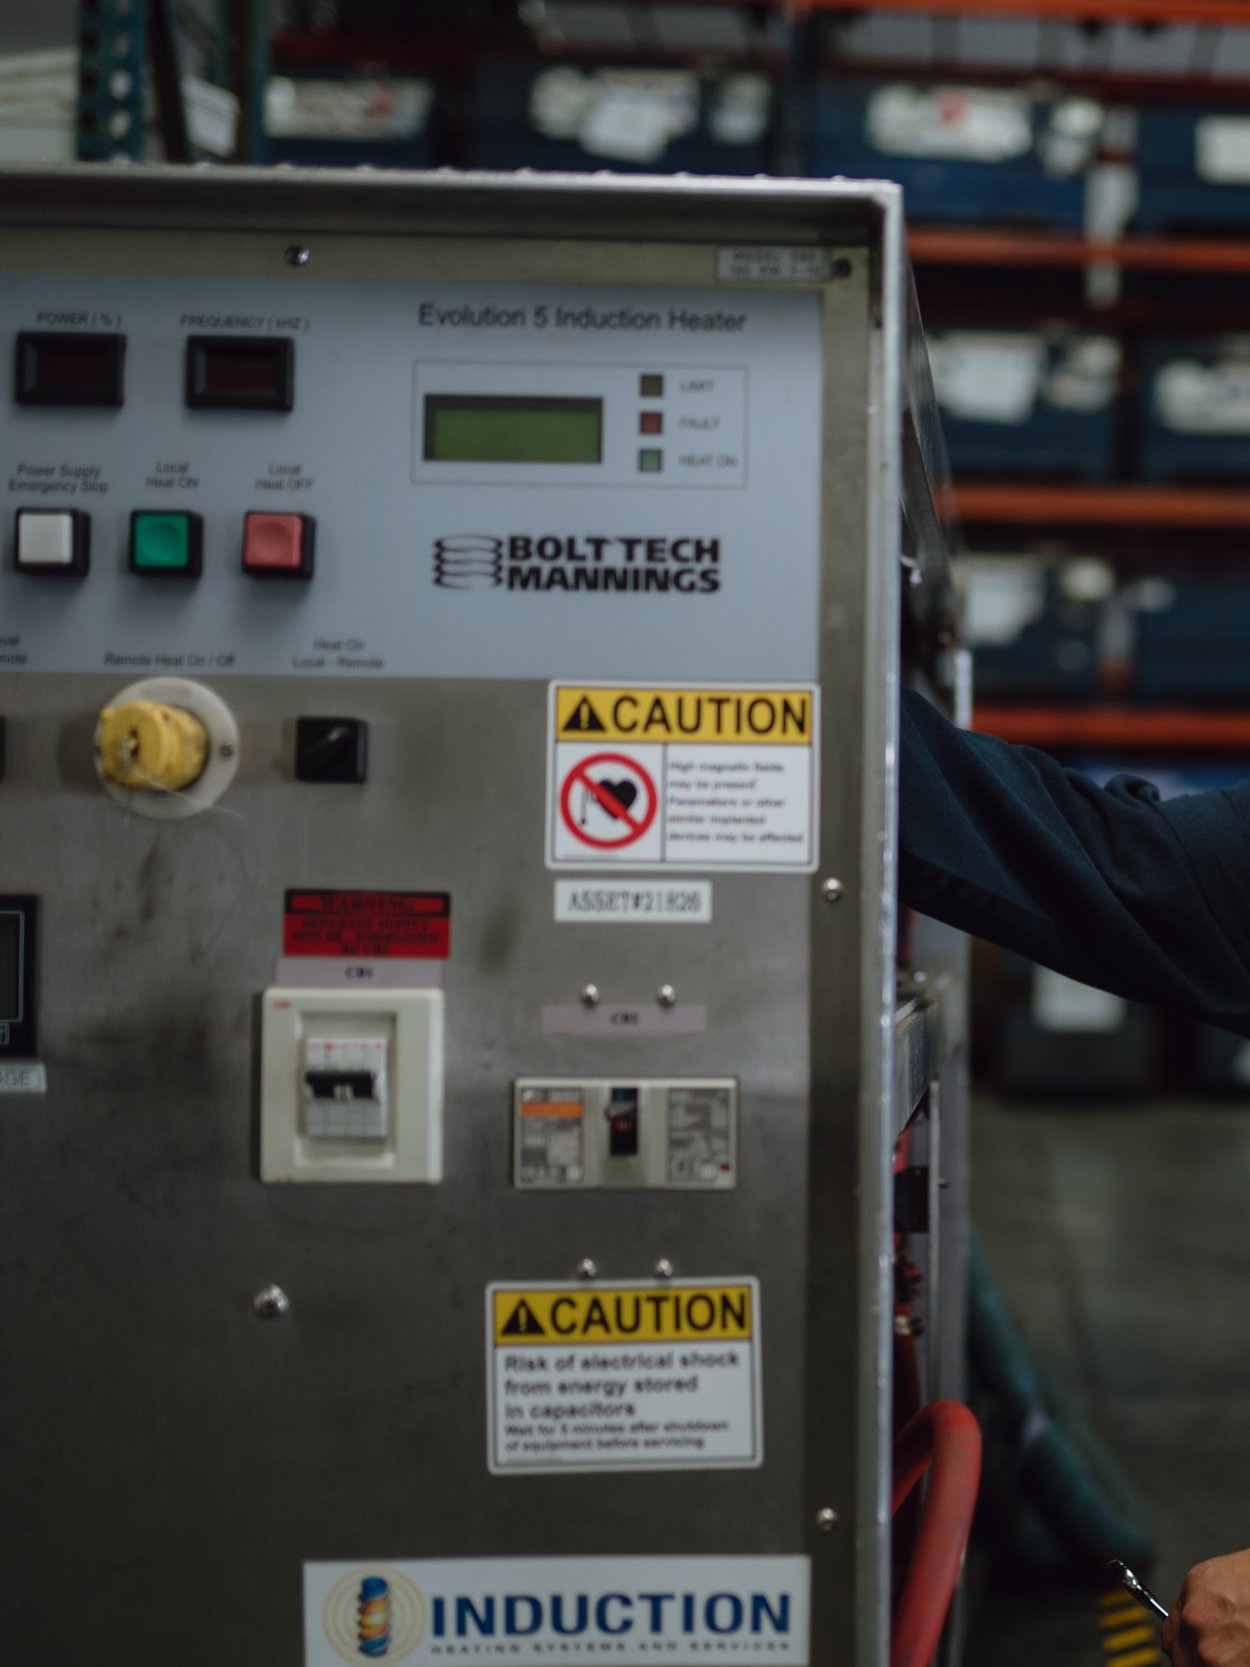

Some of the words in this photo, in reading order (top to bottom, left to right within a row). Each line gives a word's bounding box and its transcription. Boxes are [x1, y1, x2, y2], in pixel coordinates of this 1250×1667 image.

[36, 312, 89, 325] POWER
[179, 315, 265, 329] FREQUENCY
[418, 303, 525, 327] Evolution
[533, 305, 548, 328] 5
[555, 305, 661, 330] Induction
[667, 305, 746, 332] Heater
[679, 415, 720, 430] FAULT
[155, 461, 190, 474] Local
[678, 453, 714, 467] HEAT
[716, 454, 738, 468] ON
[17, 463, 57, 477] Power
[60, 463, 102, 480] Supply
[268, 462, 302, 476] Local
[8, 479, 78, 496] Emergency
[80, 480, 110, 495] Stop
[145, 477, 174, 489] Heat
[177, 477, 199, 489] ON
[255, 478, 284, 491] Heat
[286, 478, 314, 491] OFF
[506, 535, 614, 563] BOLT
[612, 538, 721, 564] TECH
[506, 565, 721, 593] MANNINGS
[313, 638, 344, 651] Heat
[348, 639, 365, 651] On
[104, 654, 151, 667] Remote
[155, 654, 185, 667] Heat
[188, 655, 206, 667] On
[218, 655, 236, 667] Off
[293, 656, 324, 669] Local
[337, 656, 384, 670] Remote
[611, 695, 807, 736] CAUTION
[551, 1293, 746, 1335] CAUTION
[505, 1355, 547, 1372] Risk
[555, 1354, 576, 1371] of
[581, 1351, 674, 1370] electrical
[679, 1350, 739, 1368] shock
[505, 1379, 551, 1396] from
[557, 1380, 627, 1398] energy
[634, 1375, 699, 1393] stored
[505, 1402, 524, 1419] in
[529, 1402, 636, 1421] capacitors
[505, 1424, 534, 1436] Wait
[538, 1423, 556, 1435] for
[571, 1423, 625, 1434] minutes
[630, 1422, 659, 1433] after
[664, 1420, 730, 1432] shutdown
[505, 1440, 519, 1450] of
[521, 1439, 592, 1453] equipment
[597, 1437, 639, 1448] before
[644, 1435, 705, 1450] servicing
[431, 1591, 792, 1638] INDUCTION
